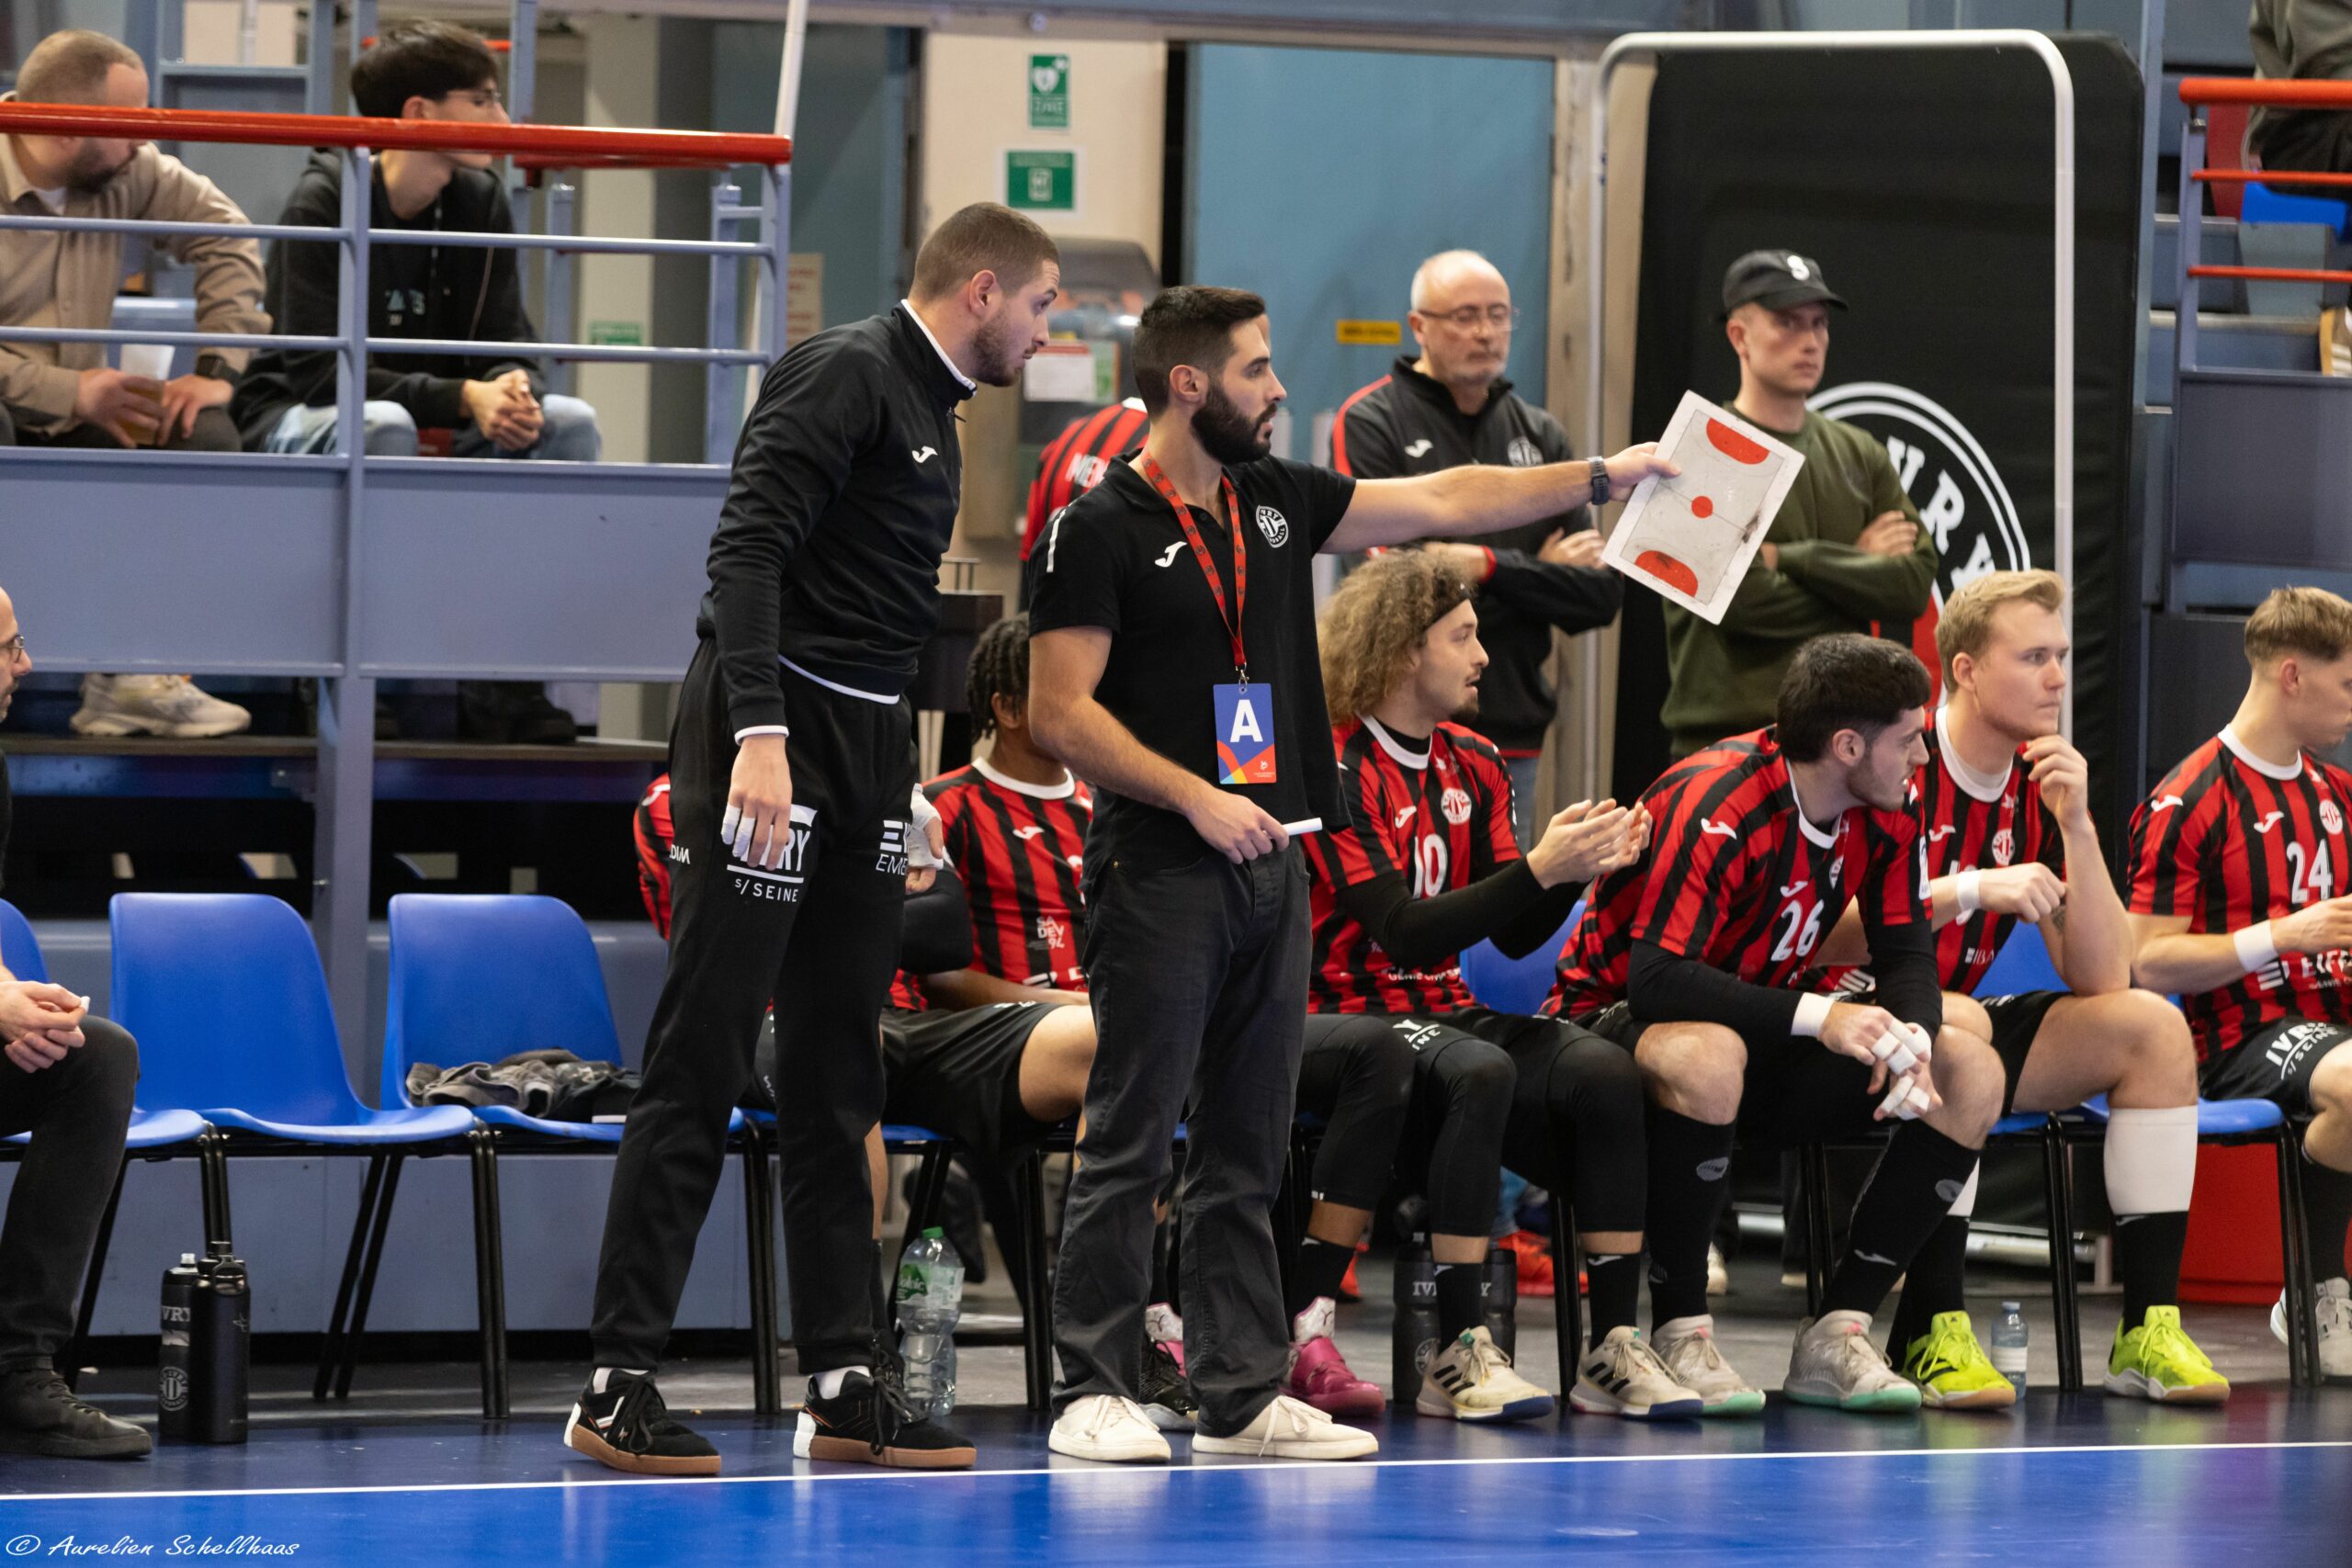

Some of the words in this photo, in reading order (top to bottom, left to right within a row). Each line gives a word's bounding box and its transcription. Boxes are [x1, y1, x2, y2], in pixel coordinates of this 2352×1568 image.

[1230, 699, 1263, 742] A
[2286, 839, 2333, 904] 24
[1771, 899, 1824, 961] 26
